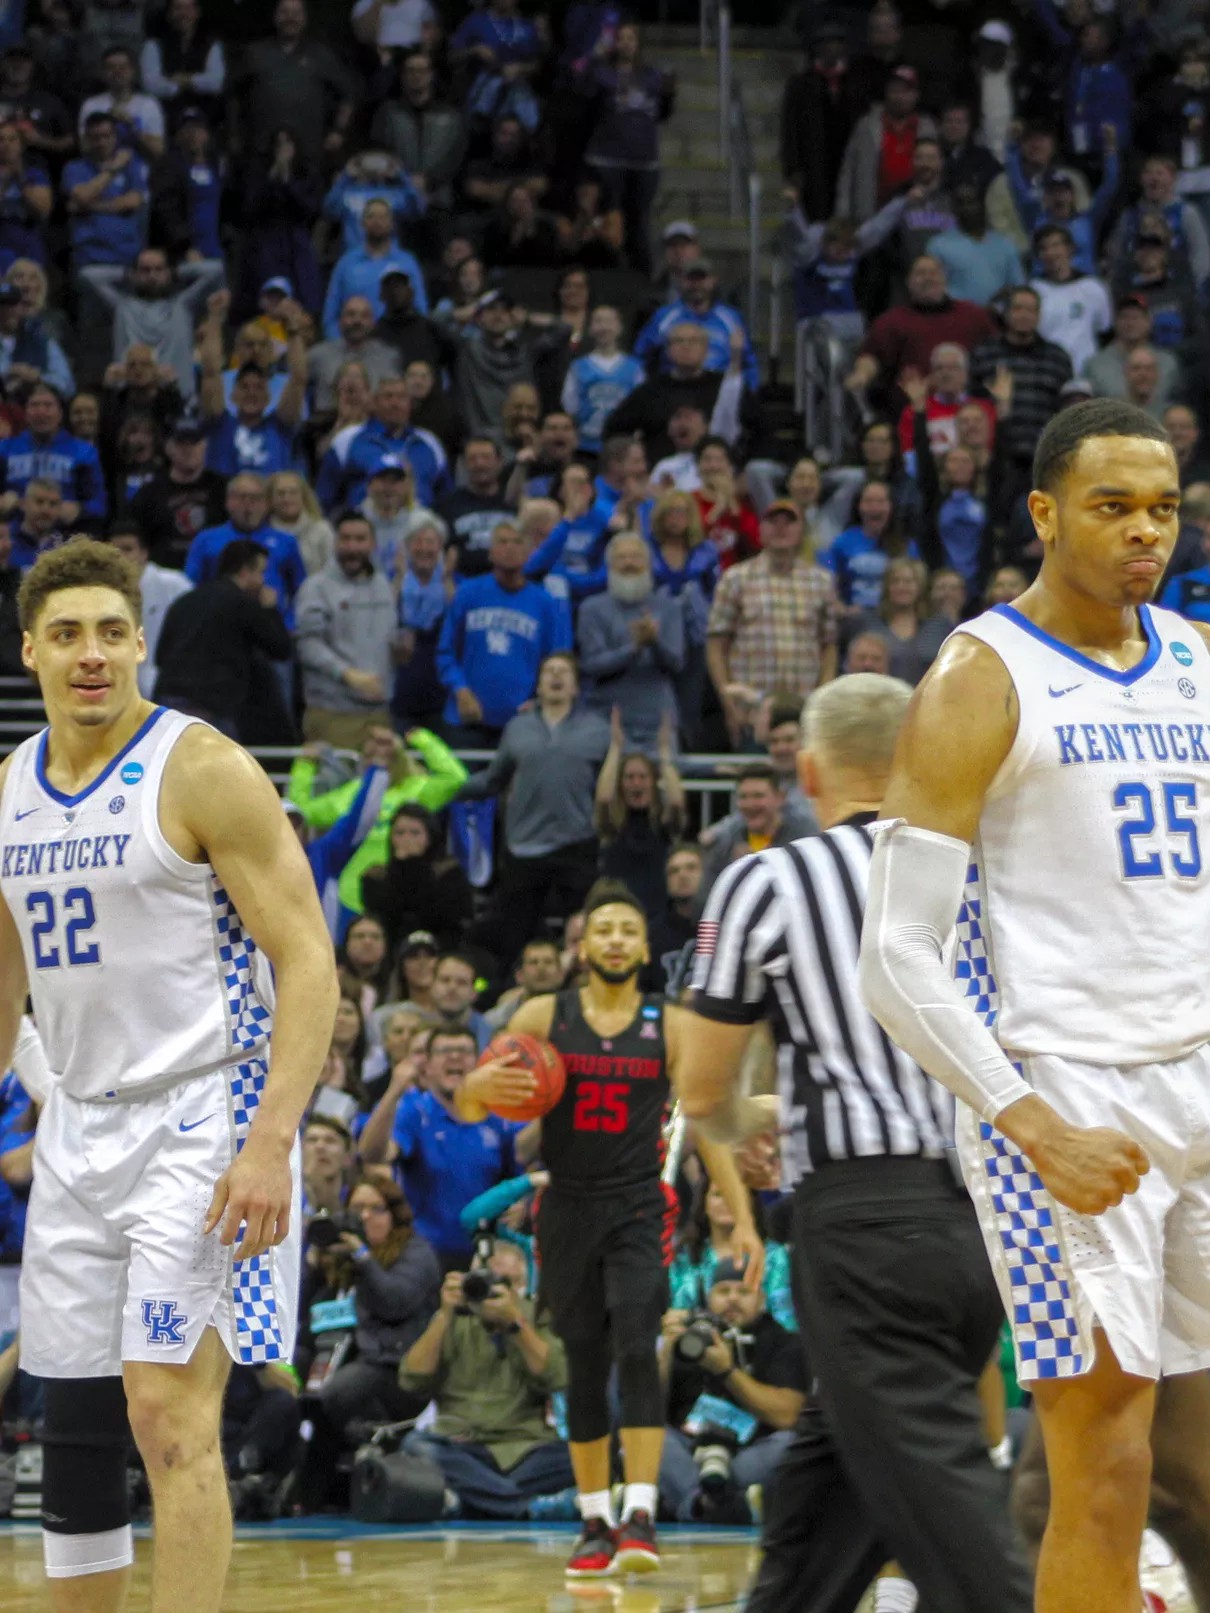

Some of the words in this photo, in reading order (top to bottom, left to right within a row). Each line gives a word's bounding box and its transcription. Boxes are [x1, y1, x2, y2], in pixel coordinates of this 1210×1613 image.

[1111, 780, 1203, 880] 25
[1, 834, 131, 878] KENTUCKY
[25, 886, 101, 969] 22
[560, 1053, 661, 1078] OUSTON
[574, 1081, 631, 1133] 25
[141, 1299, 188, 1344] UK
